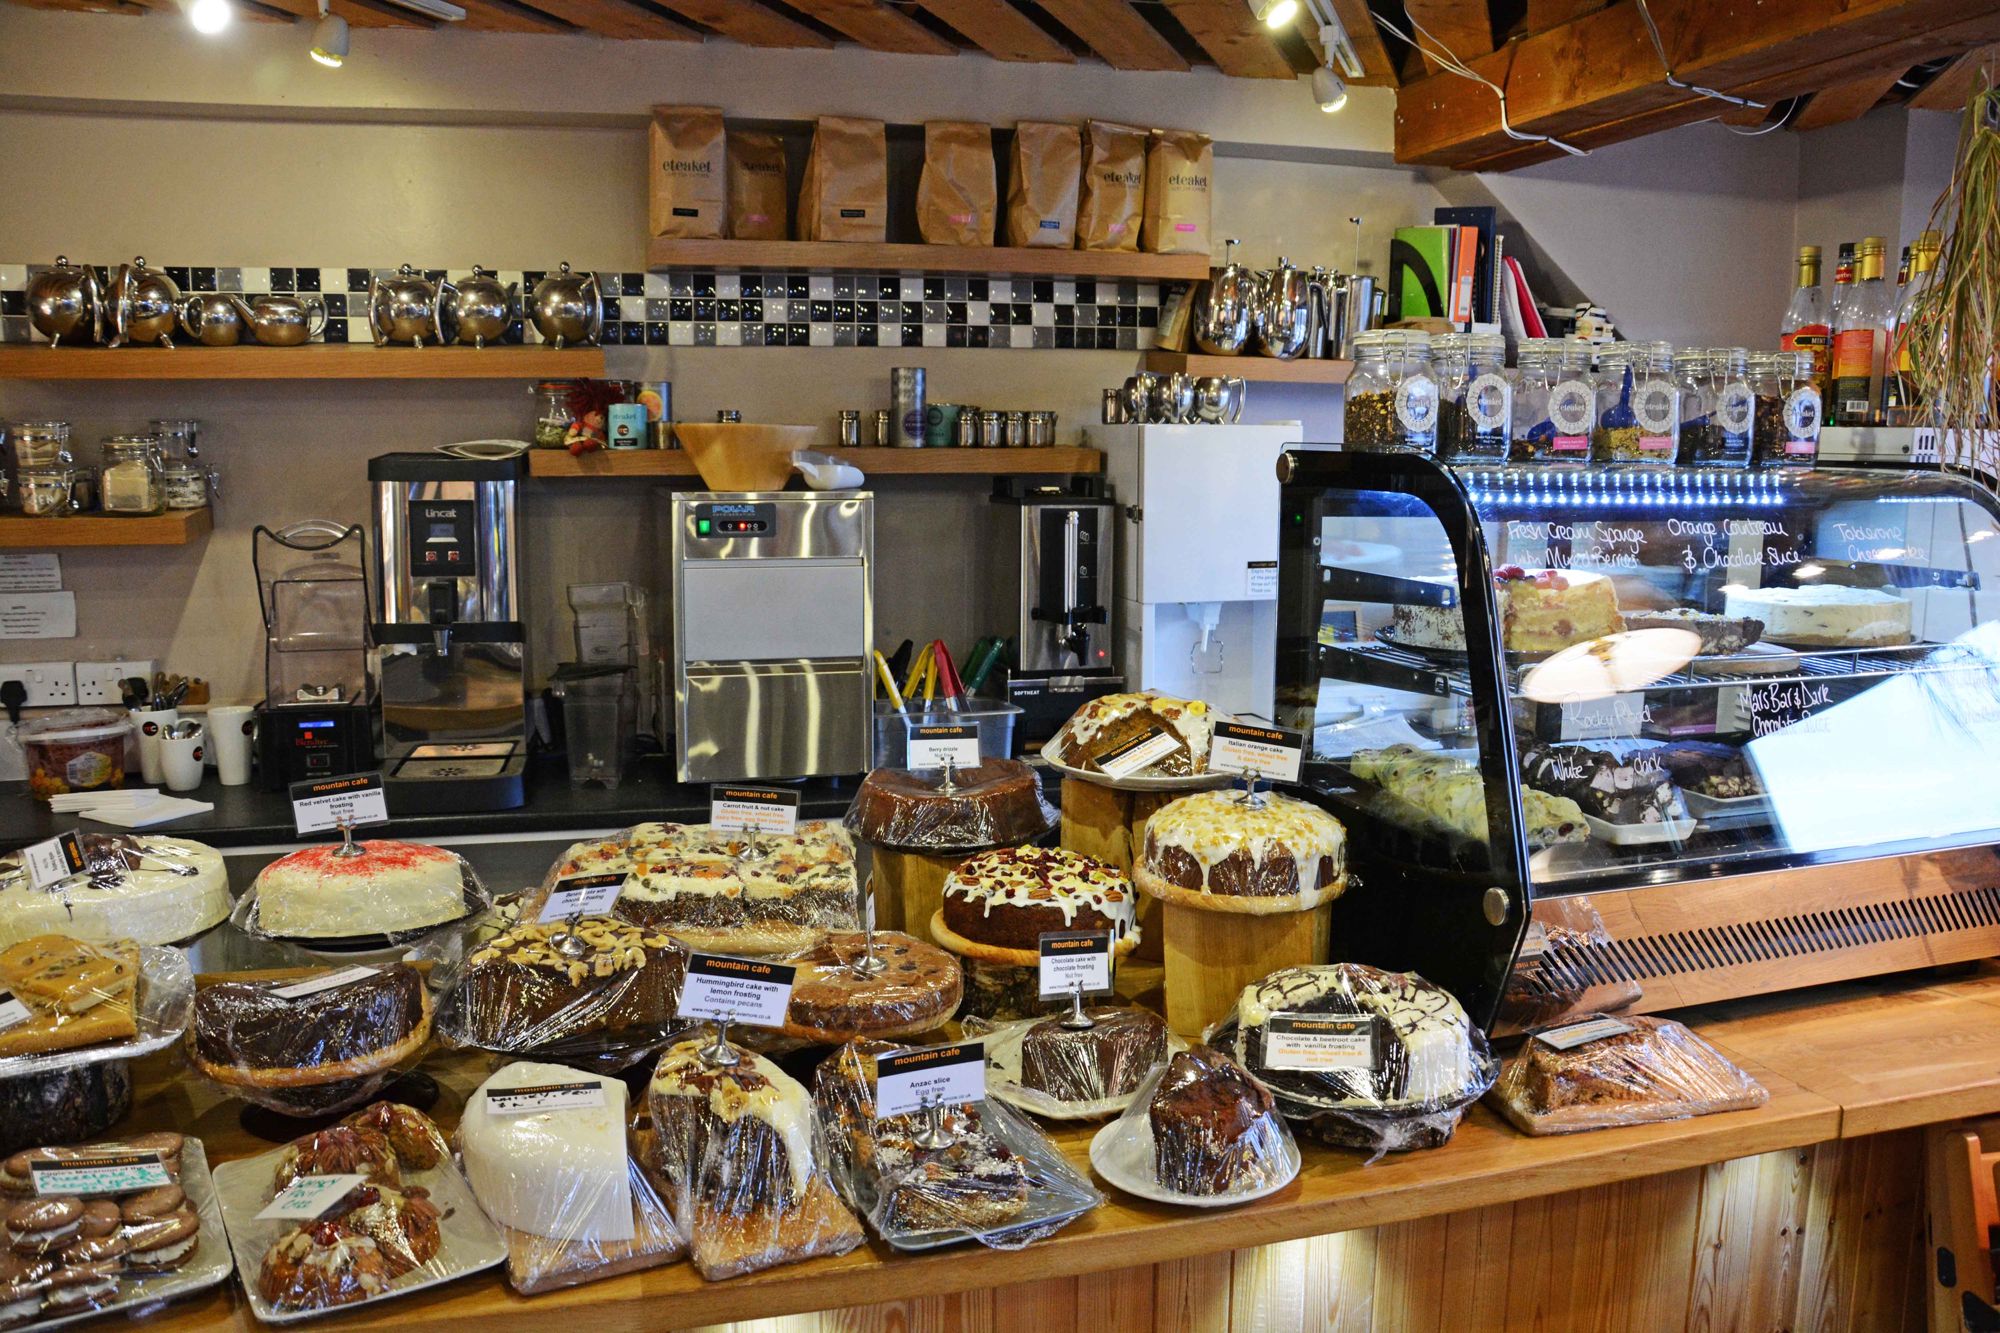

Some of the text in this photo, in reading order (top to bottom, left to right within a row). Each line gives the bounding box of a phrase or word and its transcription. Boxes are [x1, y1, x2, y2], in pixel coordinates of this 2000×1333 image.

[663, 160, 712, 172] eteaket
[1104, 172, 1141, 184] eteaket
[1169, 174, 1207, 187] eteaket
[426, 508, 457, 518] Lincat
[712, 504, 755, 513] POLAR
[1507, 520, 1647, 554] Fresh Cream Sponge
[1768, 682, 1792, 713] Bar
[1800, 681, 1834, 708] Dark
[1229, 726, 1265, 737] mountain
[1111, 739, 1139, 756] mountain
[1139, 732, 1152, 741] cafe
[313, 778, 368, 791] mountain cafe
[1052, 940, 1079, 948] mountain
[707, 959, 771, 974] mountain cafe
[696, 977, 745, 988] Hummingbird
[746, 983, 762, 991] cake
[704, 996, 736, 1005] Contains
[734, 991, 761, 1000] frosting
[895, 1048, 960, 1066] mountain cafe
